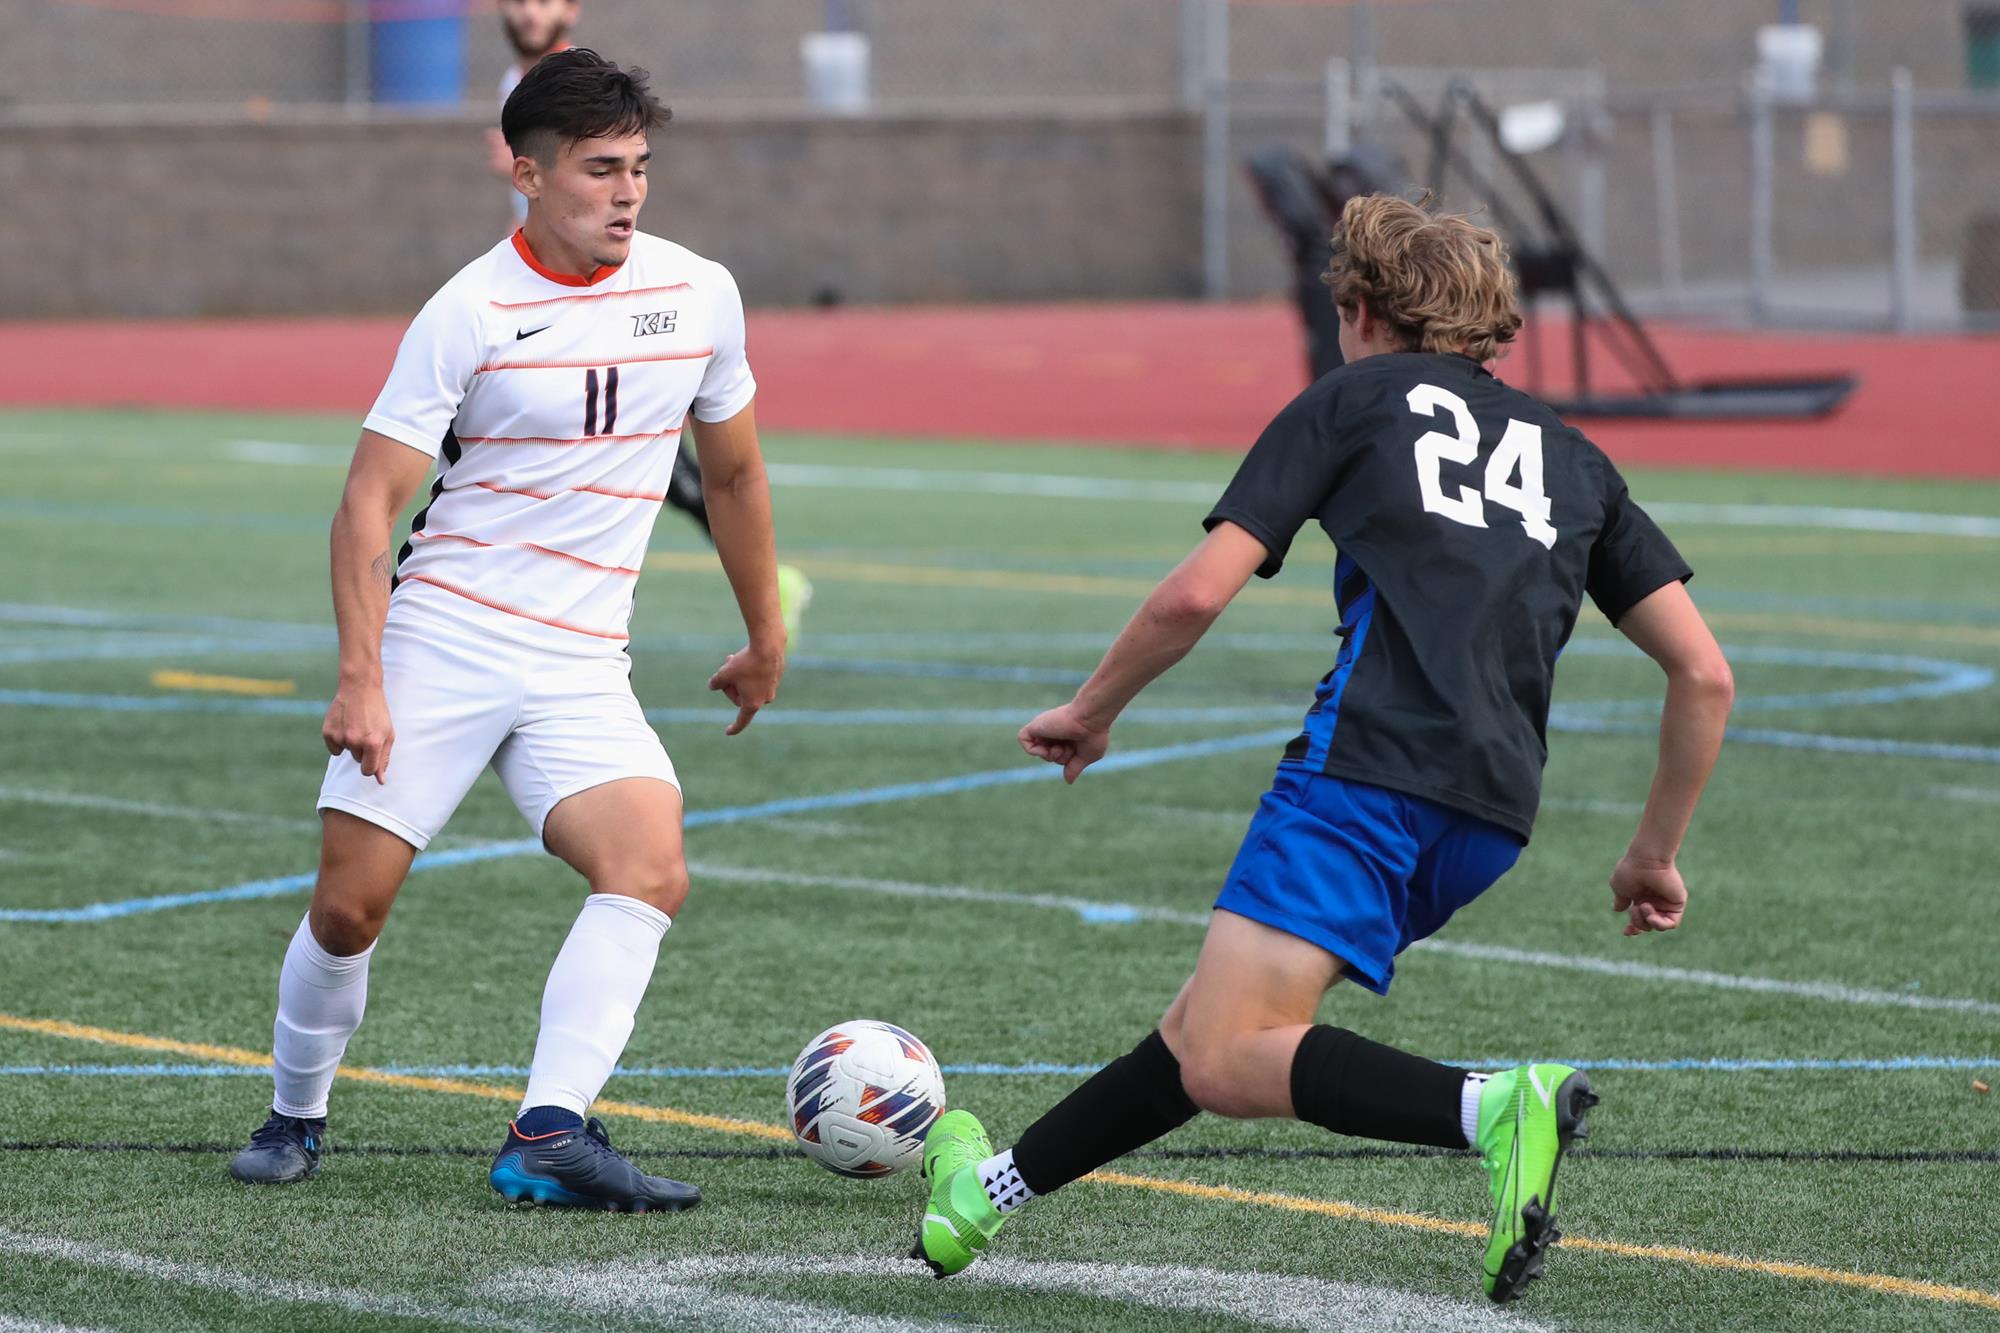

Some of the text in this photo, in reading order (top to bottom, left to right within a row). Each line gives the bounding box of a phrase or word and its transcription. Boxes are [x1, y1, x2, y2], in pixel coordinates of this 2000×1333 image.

[630, 310, 677, 337] KC
[584, 366, 618, 437] 11
[1406, 383, 1557, 550] 24
[552, 1138, 572, 1149] COPA
